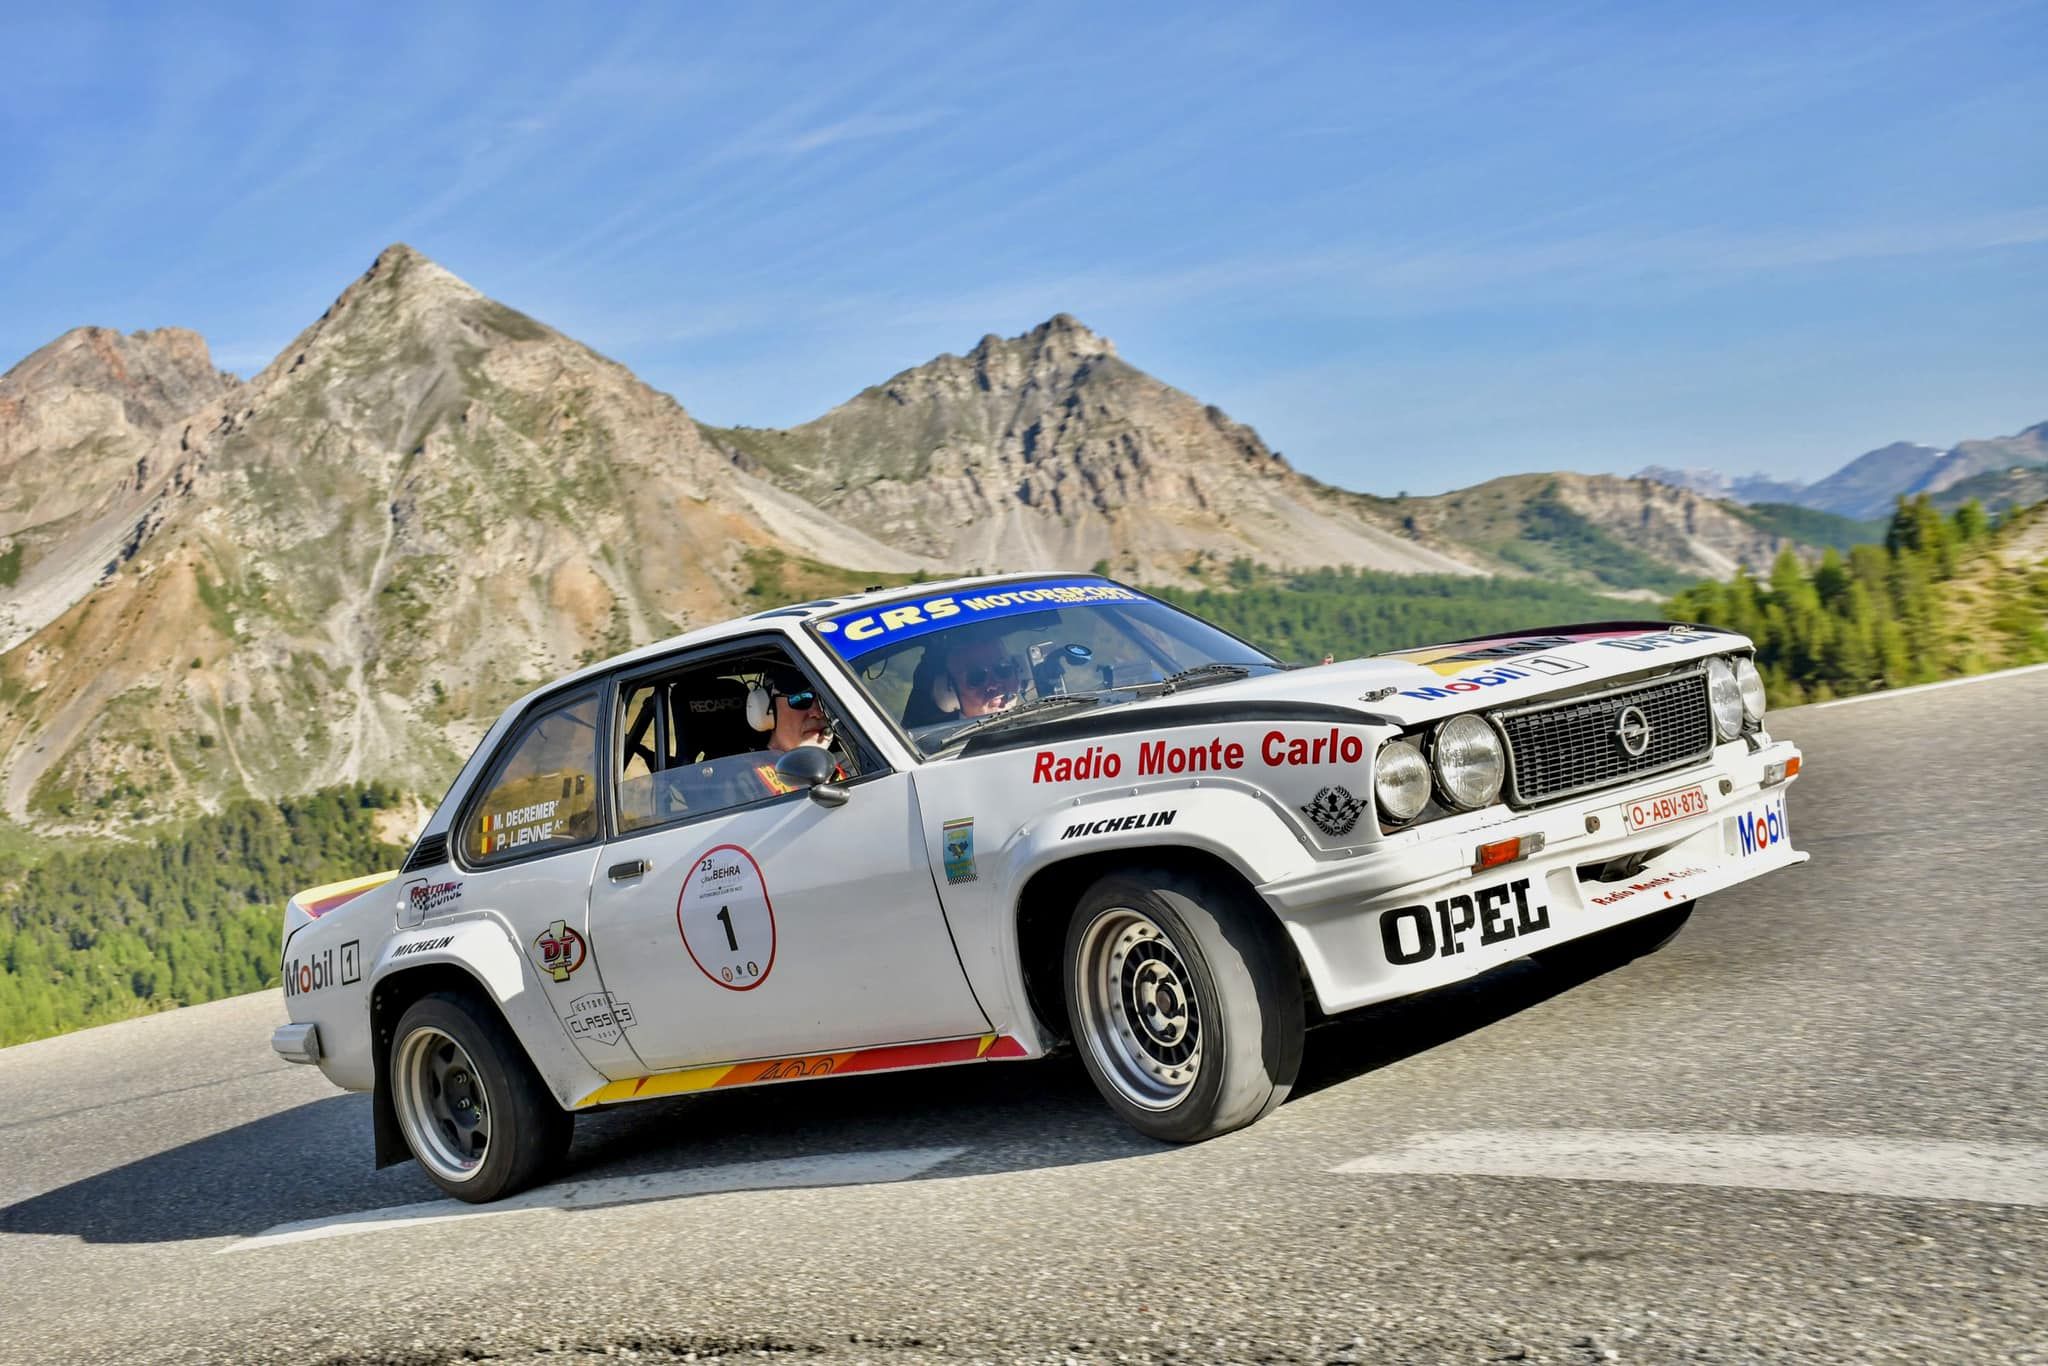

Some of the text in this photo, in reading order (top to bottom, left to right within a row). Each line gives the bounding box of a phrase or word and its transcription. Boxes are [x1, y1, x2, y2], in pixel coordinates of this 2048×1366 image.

[844, 597, 960, 641] CRS
[1399, 658, 1571, 701] Mobil 1
[1032, 728, 1363, 784] Radio Monte Carlo
[493, 800, 556, 832] M. DECREMER
[1632, 789, 1705, 826] O-ABV-873
[496, 832, 508, 852] P.
[510, 821, 553, 848] LIENNE
[1060, 810, 1177, 840] MICHELIN
[713, 865, 740, 881] BEHRA
[1591, 891, 1636, 905] Radio
[1628, 876, 1674, 891] Monte
[716, 905, 739, 952] 1
[1379, 878, 1551, 966] OPEL
[391, 935, 455, 958] MICHELIN
[539, 935, 576, 963] DT
[285, 948, 353, 998] Mobil 1
[570, 1008, 633, 1033] CLASSICS
